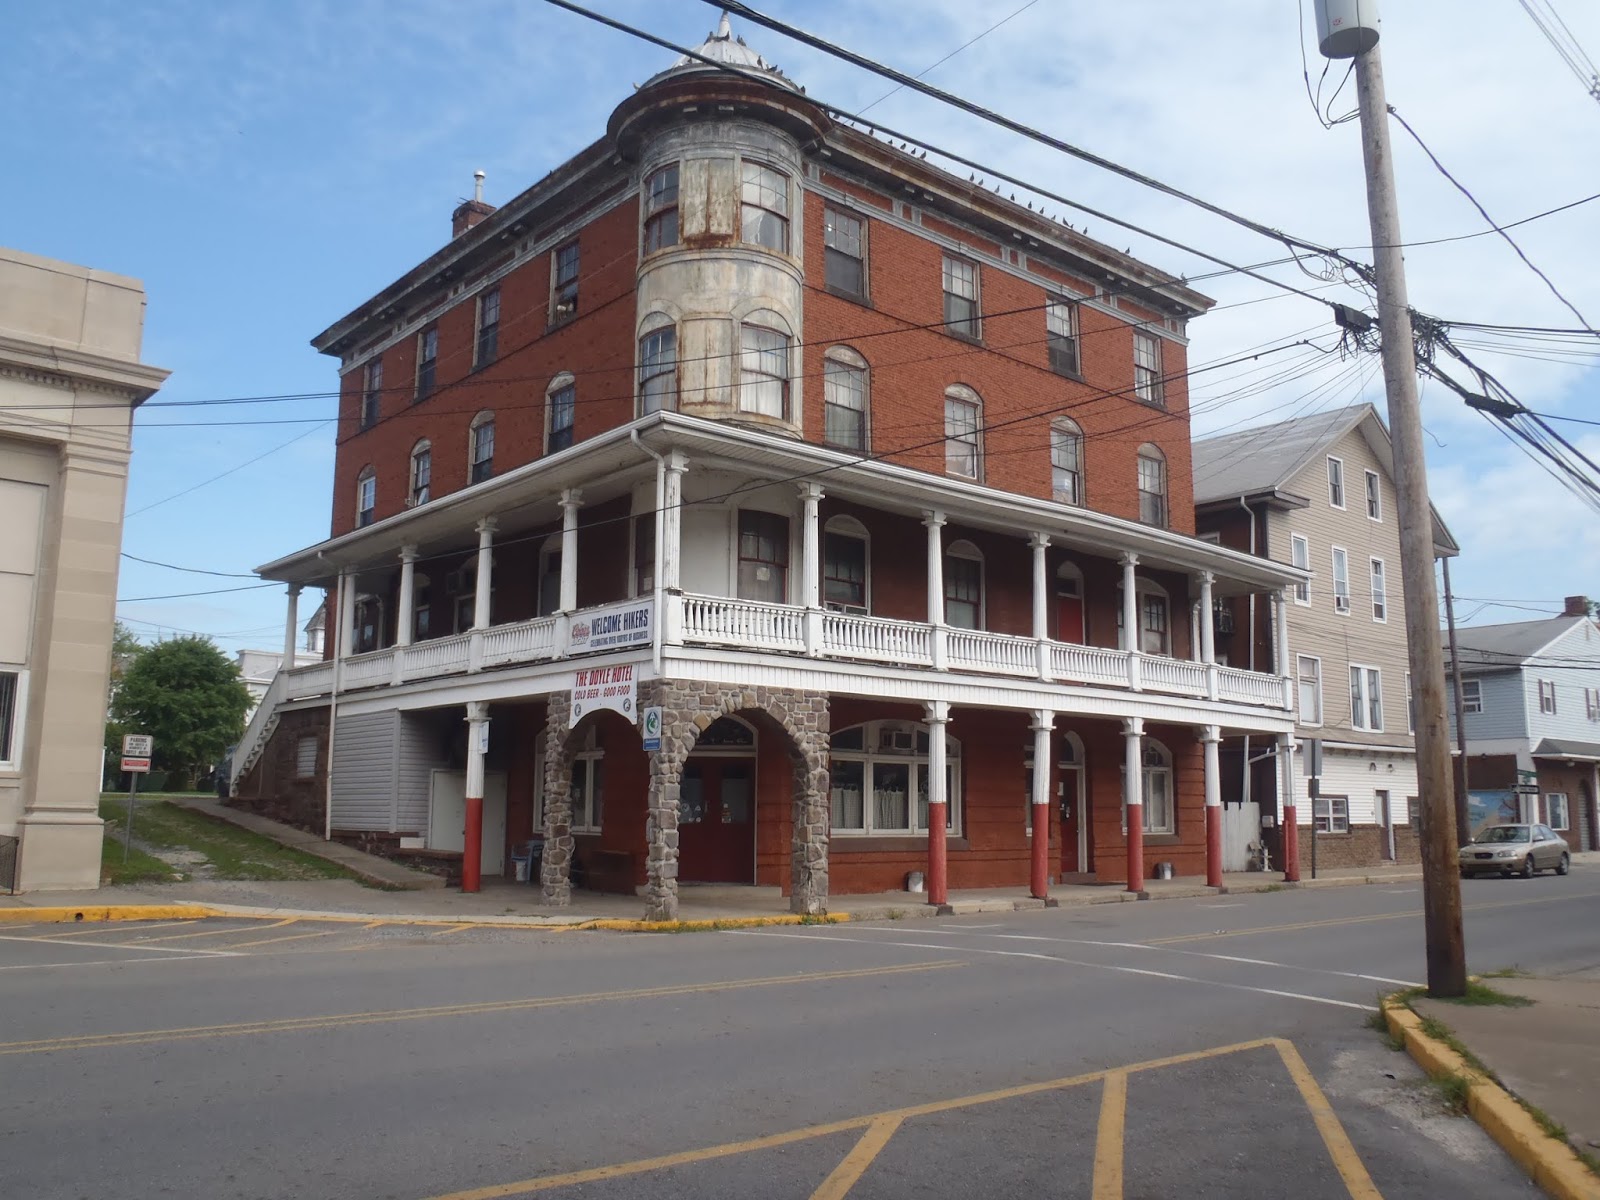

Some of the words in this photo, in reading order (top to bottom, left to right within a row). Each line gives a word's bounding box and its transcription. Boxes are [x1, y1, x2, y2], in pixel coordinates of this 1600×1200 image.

[592, 614, 621, 636] WELCOME
[623, 609, 649, 630] HIKERS
[575, 671, 588, 687] THE
[589, 668, 611, 686] DOYLE
[612, 666, 632, 683] HOTEL
[574, 689, 586, 700] COLD
[586, 688, 599, 699] BEER
[603, 686, 616, 697] GOOD
[616, 684, 631, 695] FOOD
